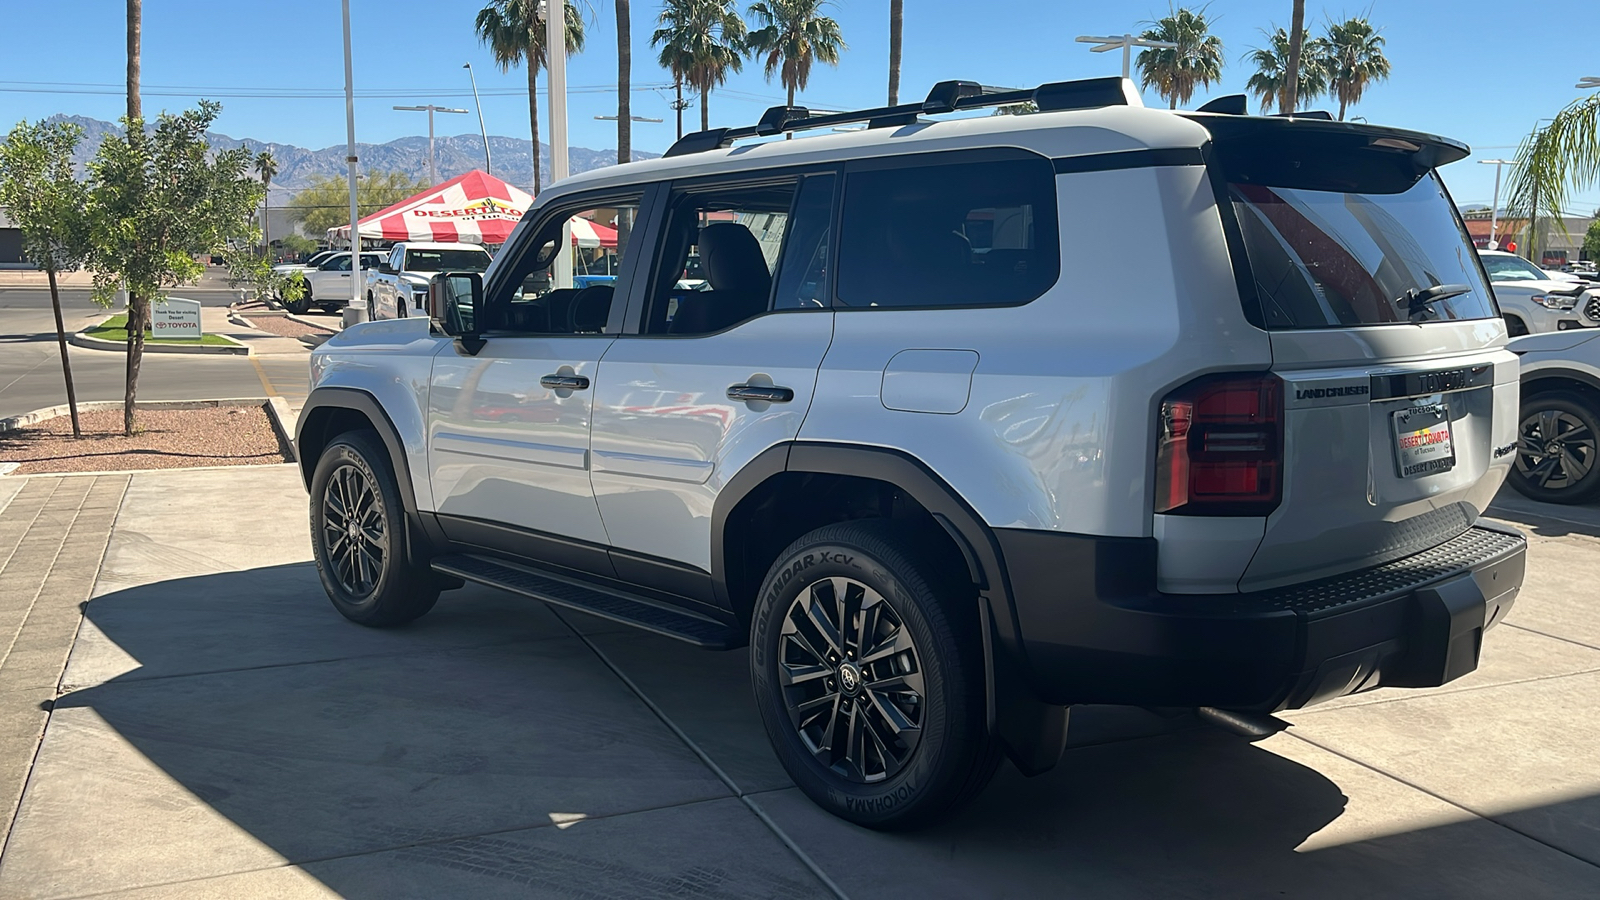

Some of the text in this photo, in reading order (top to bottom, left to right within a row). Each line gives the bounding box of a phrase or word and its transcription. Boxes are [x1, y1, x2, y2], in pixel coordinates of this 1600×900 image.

[414, 207, 489, 217] DESERT
[1419, 370, 1466, 394] TOYOTA
[1296, 386, 1369, 400] LAND CRUISER
[1409, 405, 1436, 415] TUCSON
[1399, 430, 1450, 449] DESERT TOYOTA
[1420, 446, 1435, 455] Tucson
[1404, 462, 1427, 476] DESERT
[753, 554, 815, 663] GEOLANDAR
[845, 780, 915, 813] YOKOHAMA
